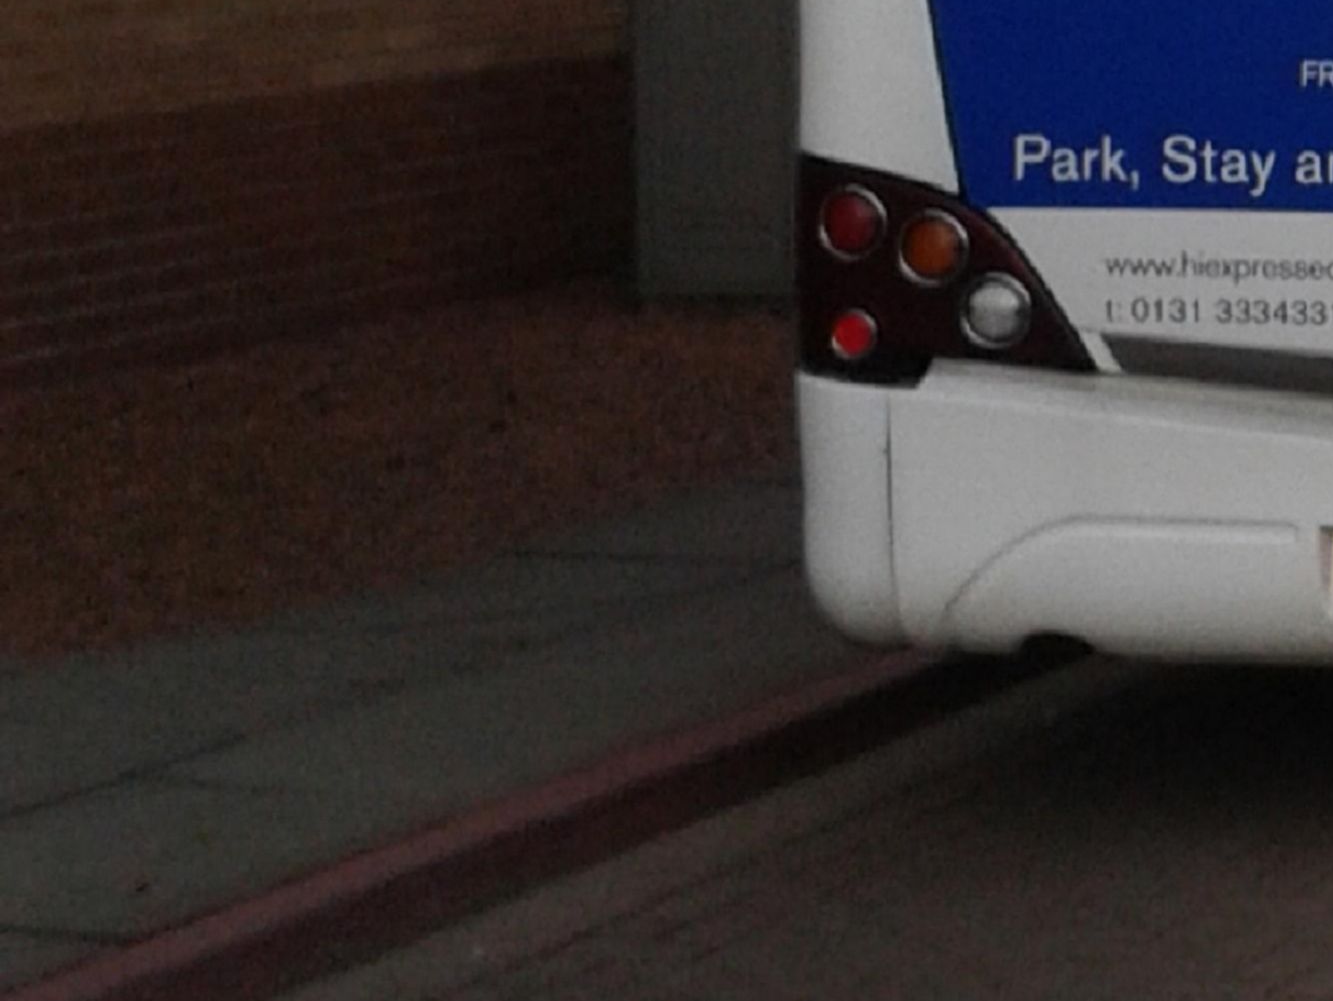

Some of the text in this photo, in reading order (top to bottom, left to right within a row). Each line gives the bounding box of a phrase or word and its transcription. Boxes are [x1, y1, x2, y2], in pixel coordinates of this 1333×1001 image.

[1012, 133, 1141, 192] Park,
[1160, 134, 1277, 197] Stay
[1130, 296, 1200, 324] 0131
